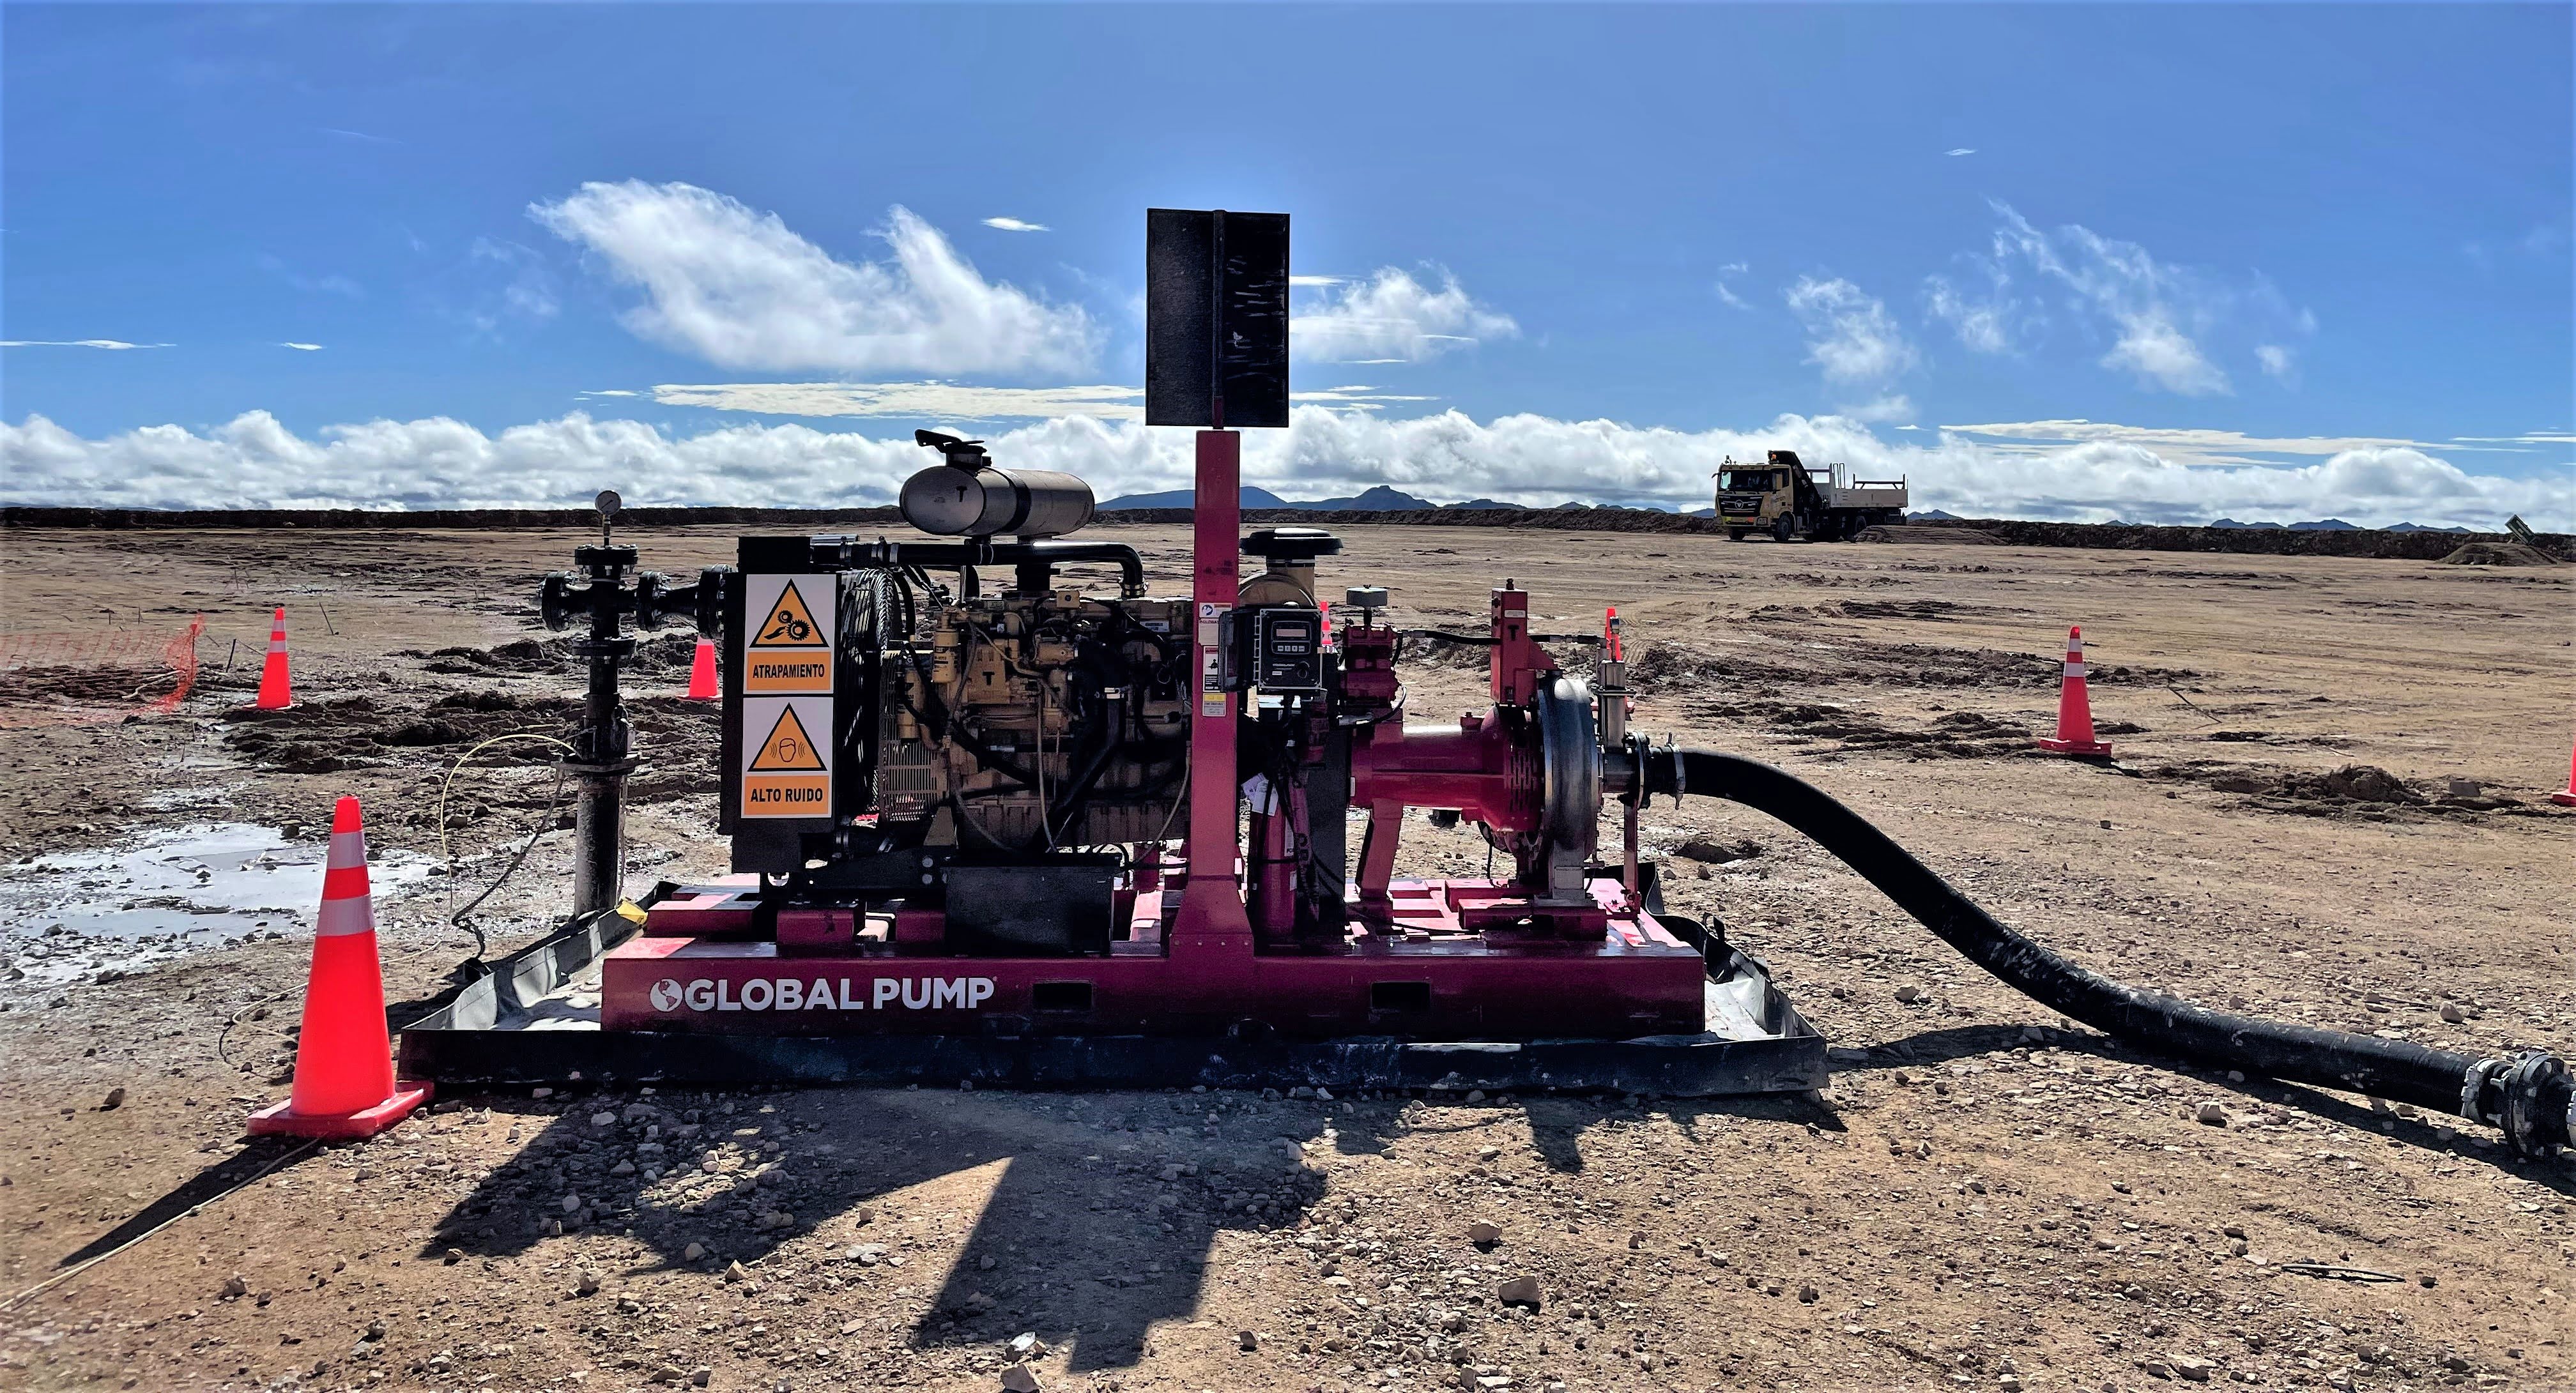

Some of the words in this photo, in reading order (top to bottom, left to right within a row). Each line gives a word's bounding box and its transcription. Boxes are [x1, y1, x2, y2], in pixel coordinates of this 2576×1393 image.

[752, 664, 825, 678] ATRAPAMIENTO
[750, 788, 781, 802] ALTO
[785, 788, 823, 802] RUIDO
[684, 978, 864, 1012] GLOBAL
[873, 977, 995, 1009] PUMP
